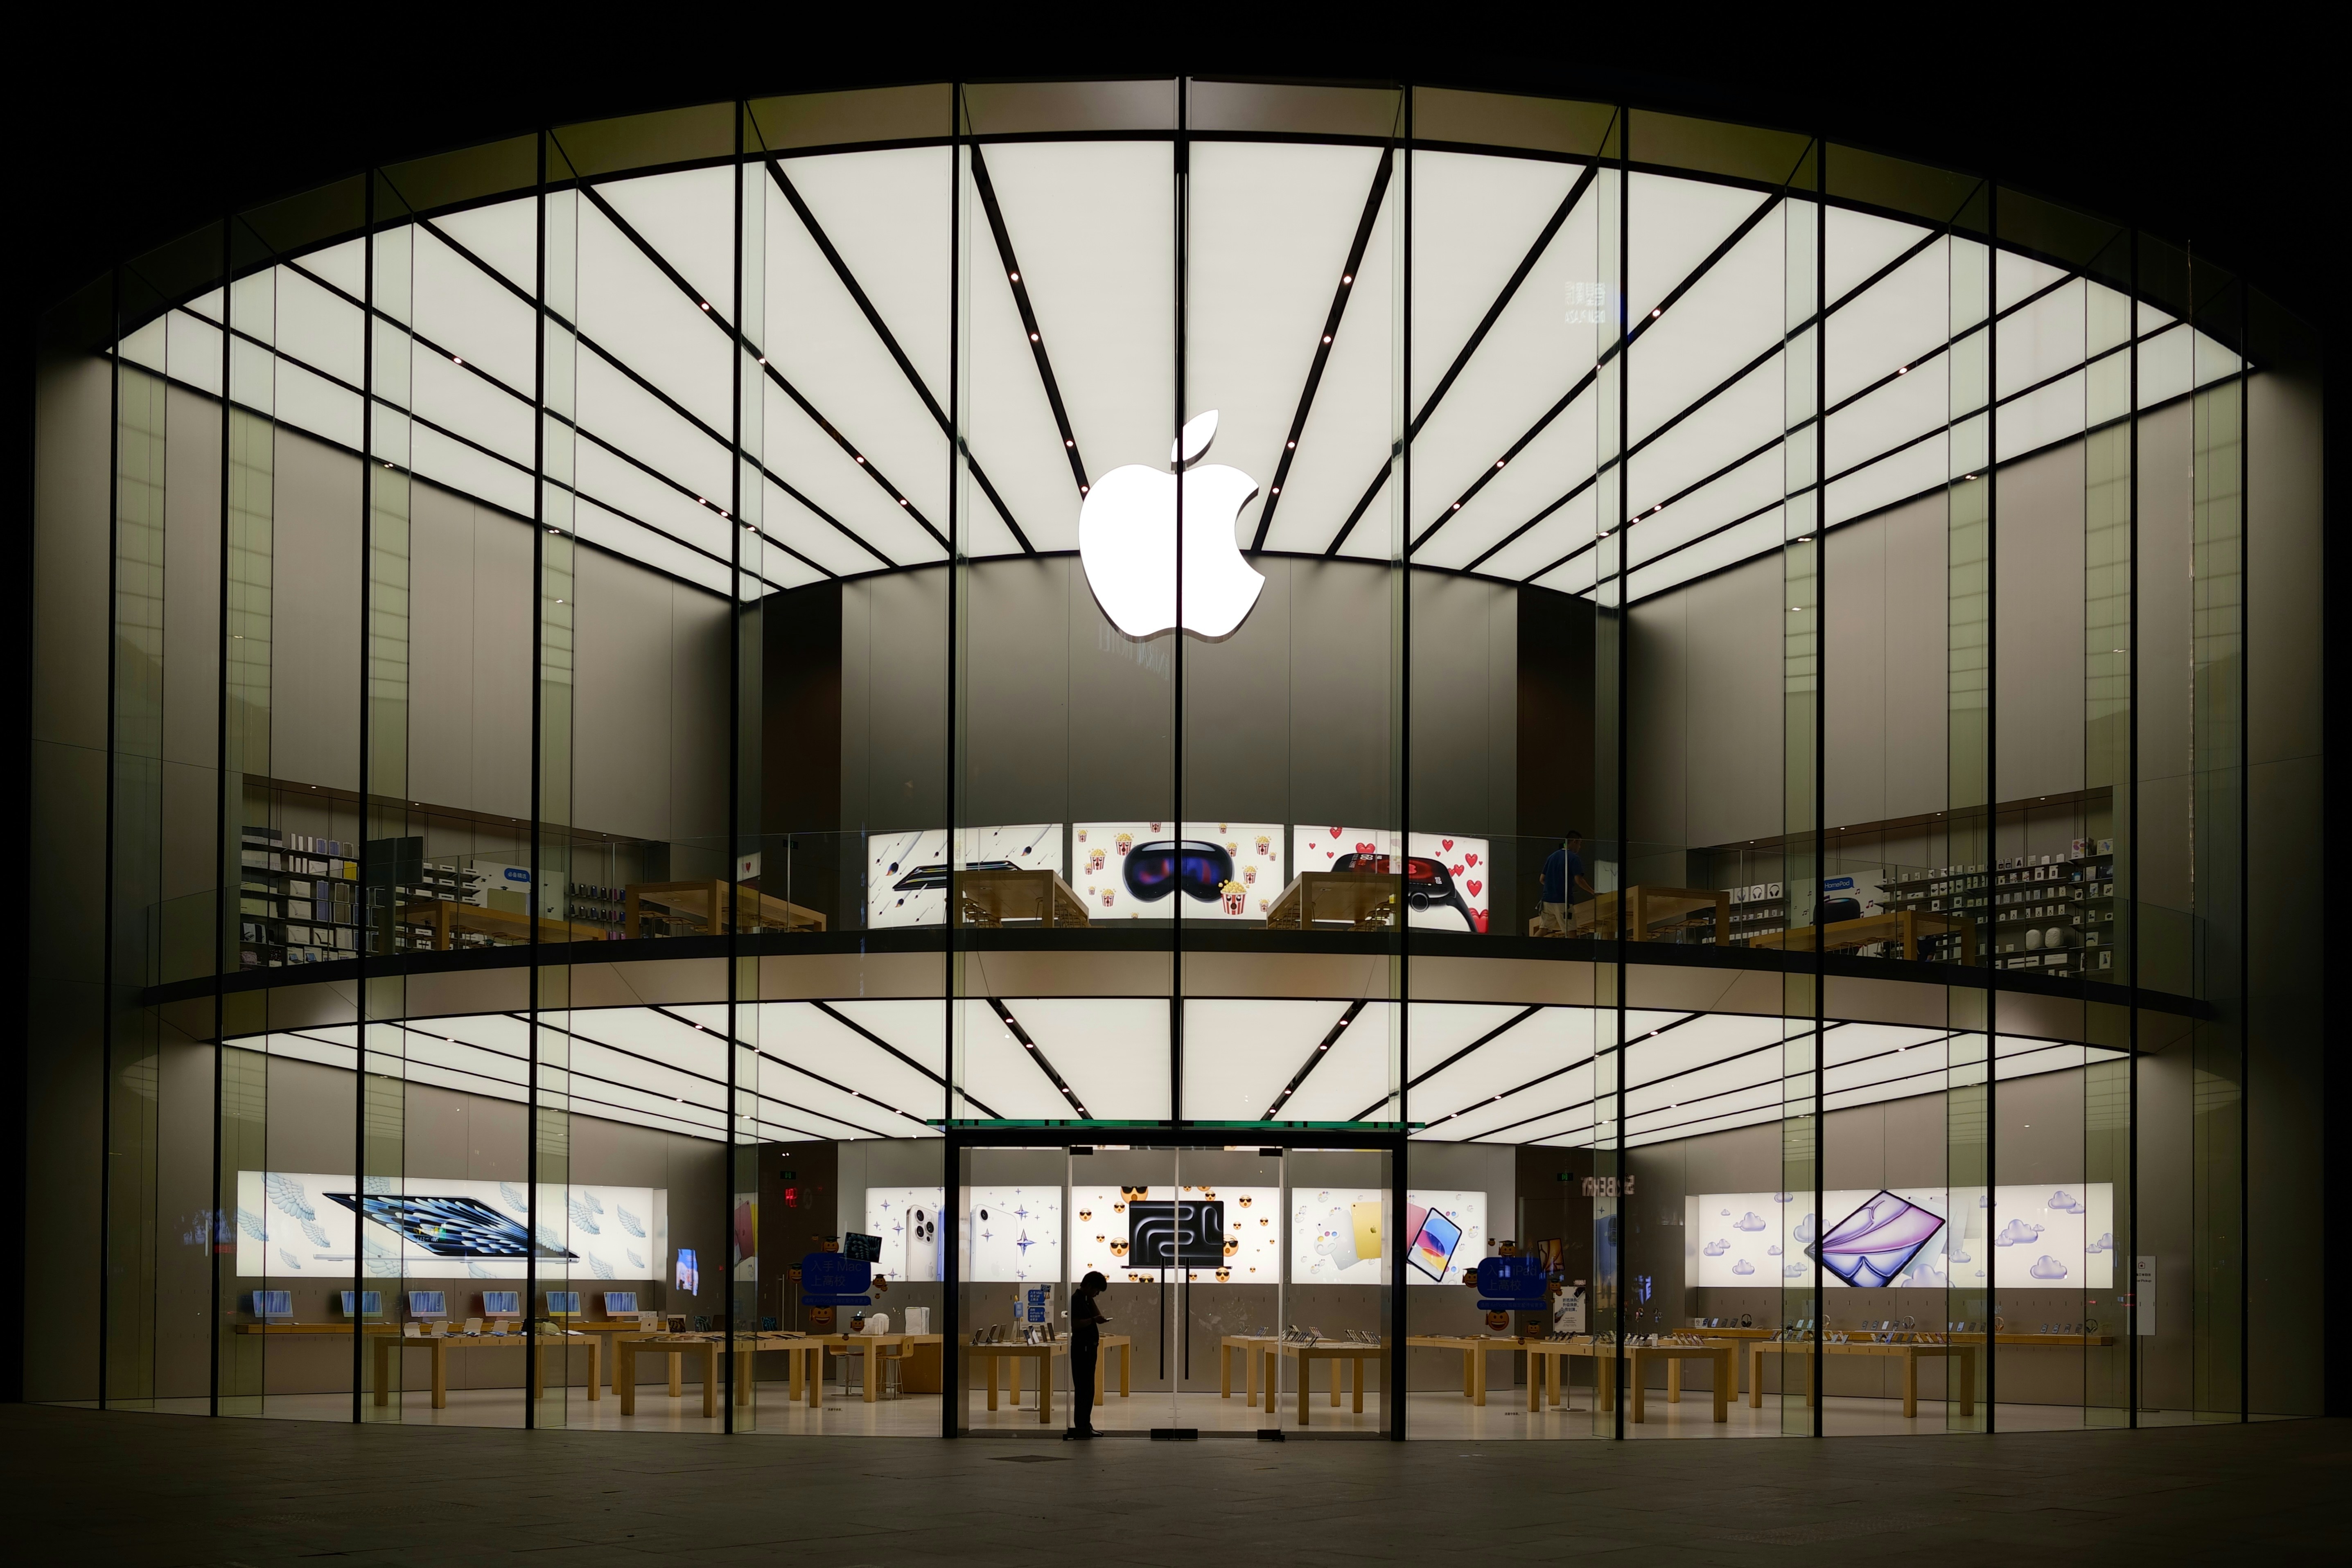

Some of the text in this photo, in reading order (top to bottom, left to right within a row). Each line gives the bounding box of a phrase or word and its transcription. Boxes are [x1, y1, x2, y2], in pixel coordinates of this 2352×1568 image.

[1824, 880, 1850, 888] HomePod
[811, 1260, 862, 1272] 入手 Mac
[1513, 1265, 1537, 1276] iPad
[811, 1275, 846, 1286] 上高校
[1487, 1279, 1522, 1290] 上高校
